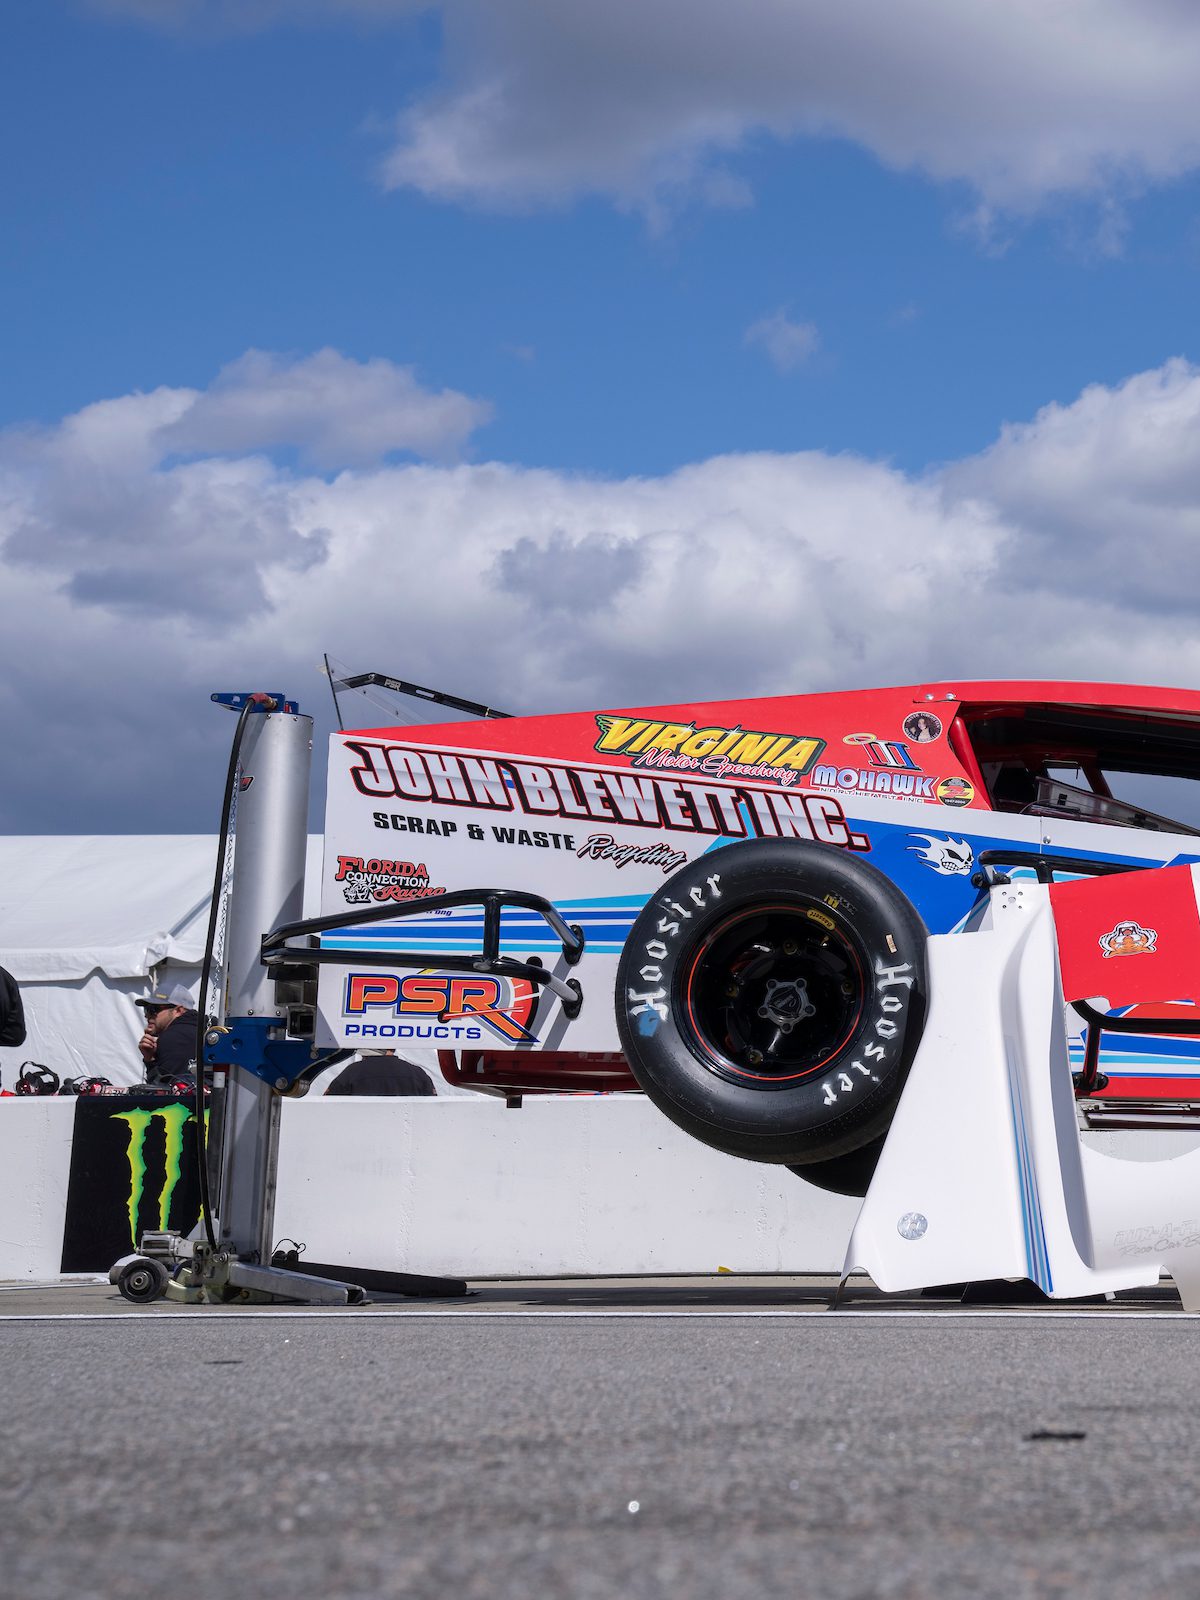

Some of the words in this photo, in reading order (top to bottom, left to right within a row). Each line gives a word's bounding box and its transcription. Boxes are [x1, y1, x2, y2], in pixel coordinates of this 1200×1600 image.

[384, 679, 401, 691] PSR
[597, 716, 821, 771] VIRGINIA
[635, 748, 699, 769] Motor
[700, 755, 798, 786] Speedway
[343, 741, 515, 812] JOHN
[497, 760, 749, 839] BLEWETT
[736, 787, 872, 852] INC.
[373, 812, 457, 837] SCRAP
[467, 824, 485, 841] &
[492, 826, 576, 850] WASTE
[578, 834, 687, 873] Recycling
[335, 856, 429, 881] FLORIDA
[345, 871, 429, 888] CONNECTION
[373, 885, 447, 902] Racing
[628, 873, 722, 1022] Hoosier
[345, 972, 540, 1043] PSR
[345, 1024, 482, 1039] PRODUCTS
[822, 957, 916, 1106] Hoosier
